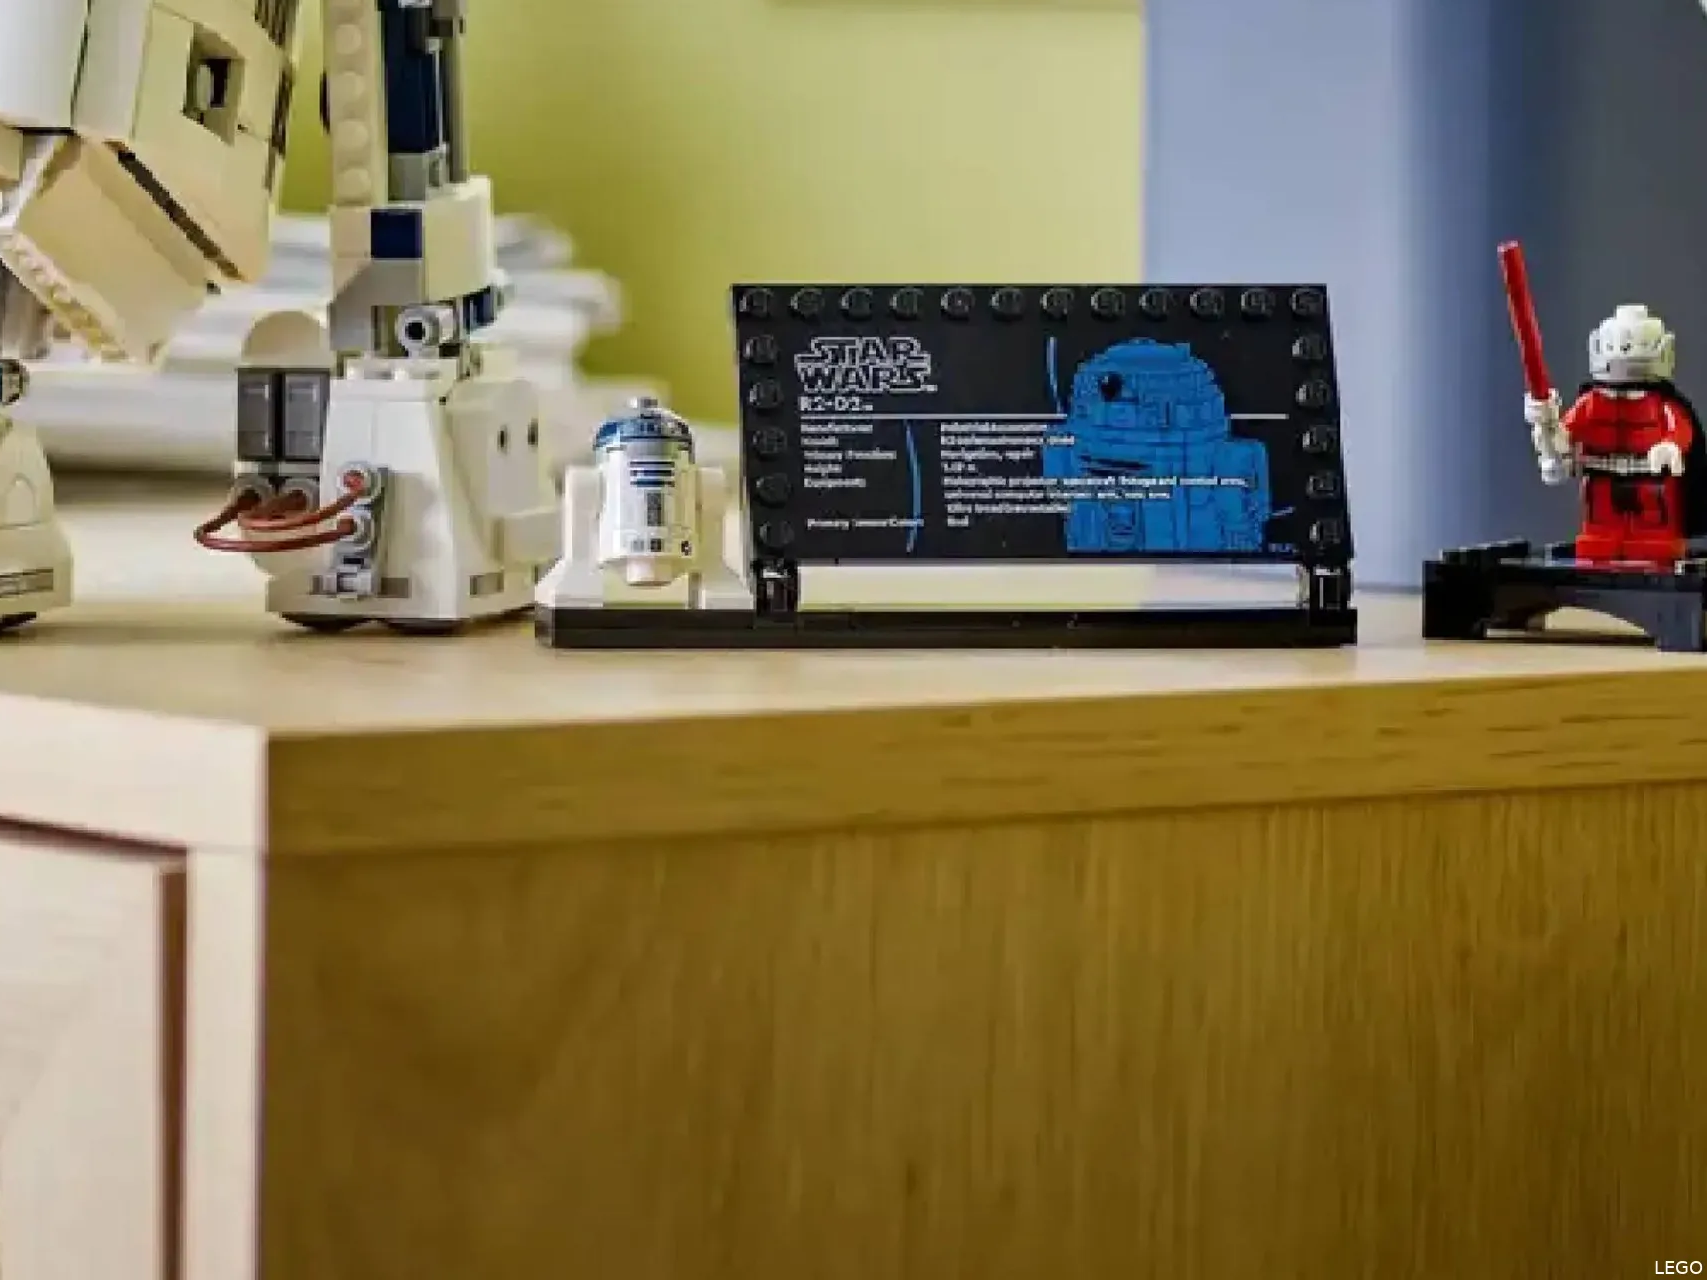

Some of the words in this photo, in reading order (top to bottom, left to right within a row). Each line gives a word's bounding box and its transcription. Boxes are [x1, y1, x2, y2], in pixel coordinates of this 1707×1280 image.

[795, 337, 931, 367] STAR
[797, 365, 931, 393] WARS
[800, 396, 861, 411] R2-D2
